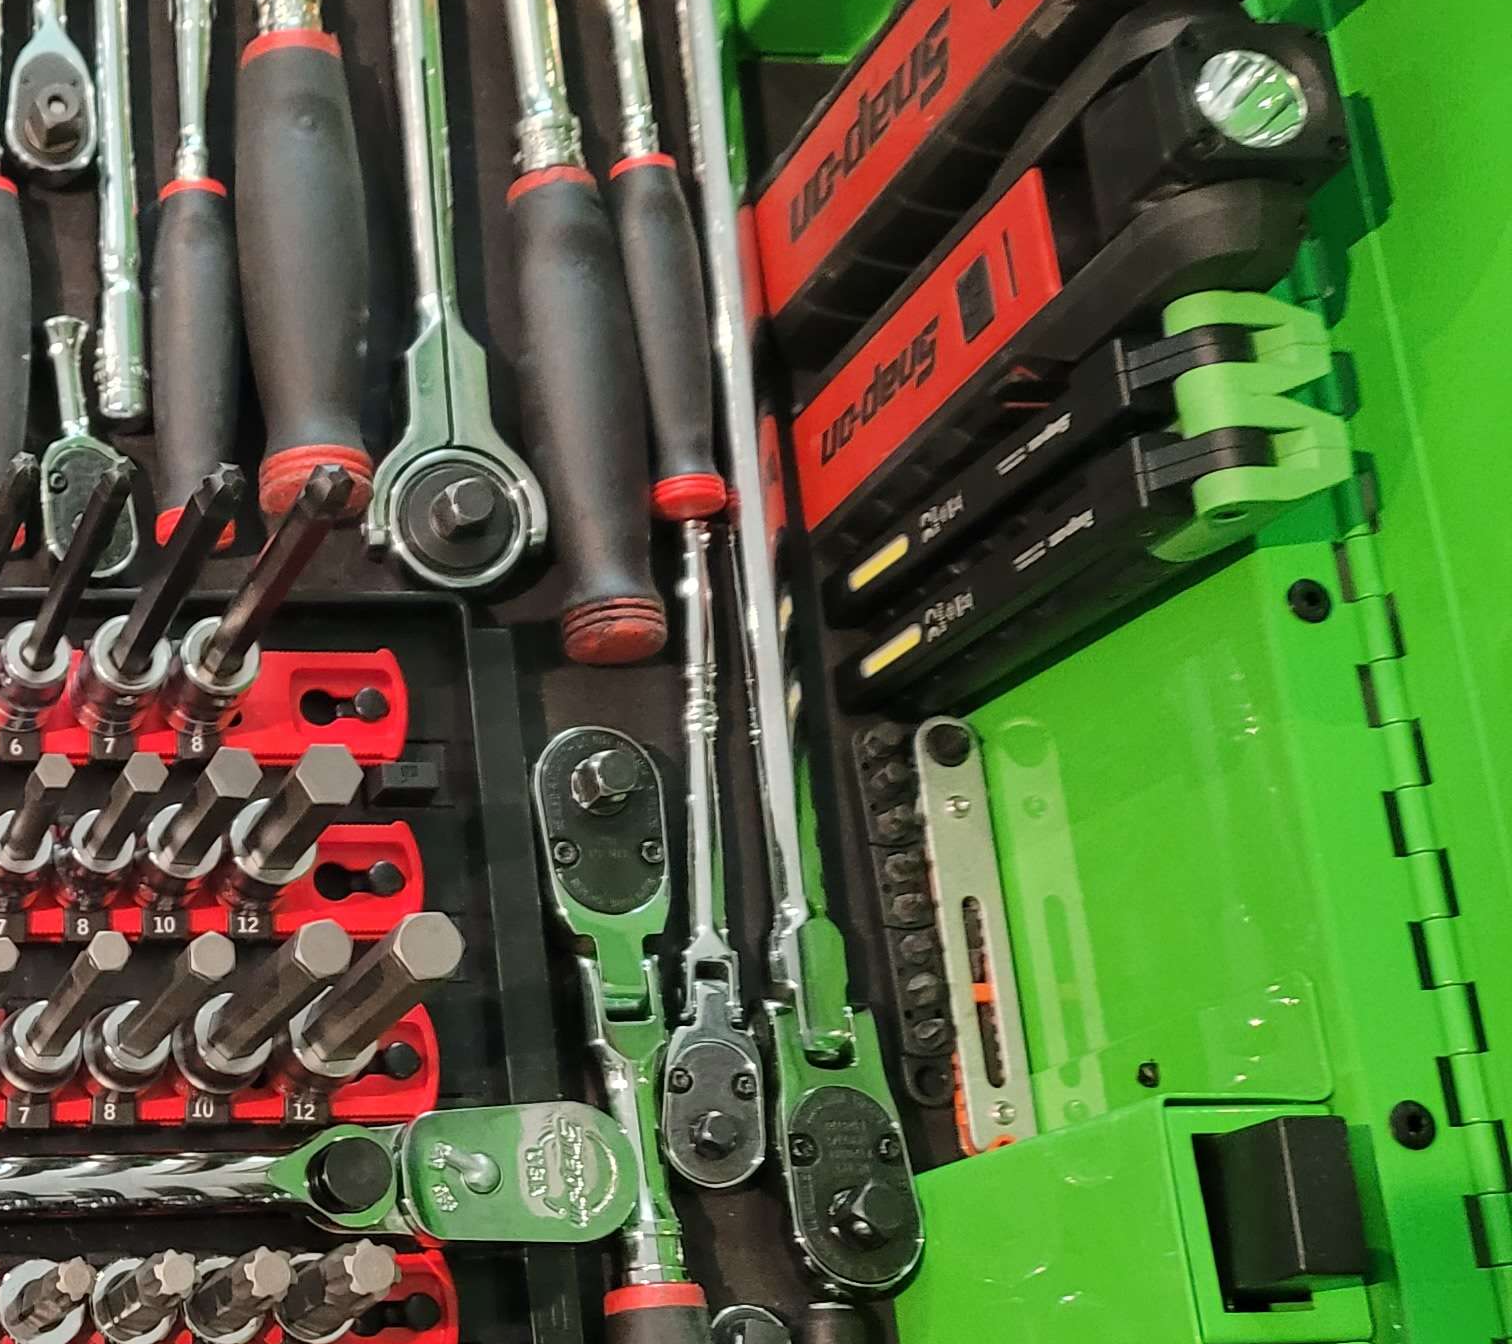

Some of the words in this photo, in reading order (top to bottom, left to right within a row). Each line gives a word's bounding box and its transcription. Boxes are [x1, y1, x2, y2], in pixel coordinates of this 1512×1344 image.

[788, 8, 954, 246] Snap-on
[819, 314, 939, 466] Snap-on
[9, 738, 22, 756] 6
[104, 737, 115, 755] 7
[191, 735, 204, 753] 8
[76, 919, 89, 938] 8
[153, 916, 176, 935] 10
[236, 916, 260, 935] 12
[17, 1106, 31, 1126] 7
[103, 1102, 116, 1121] 8
[190, 1099, 215, 1119] 10
[293, 1102, 316, 1122] 12
